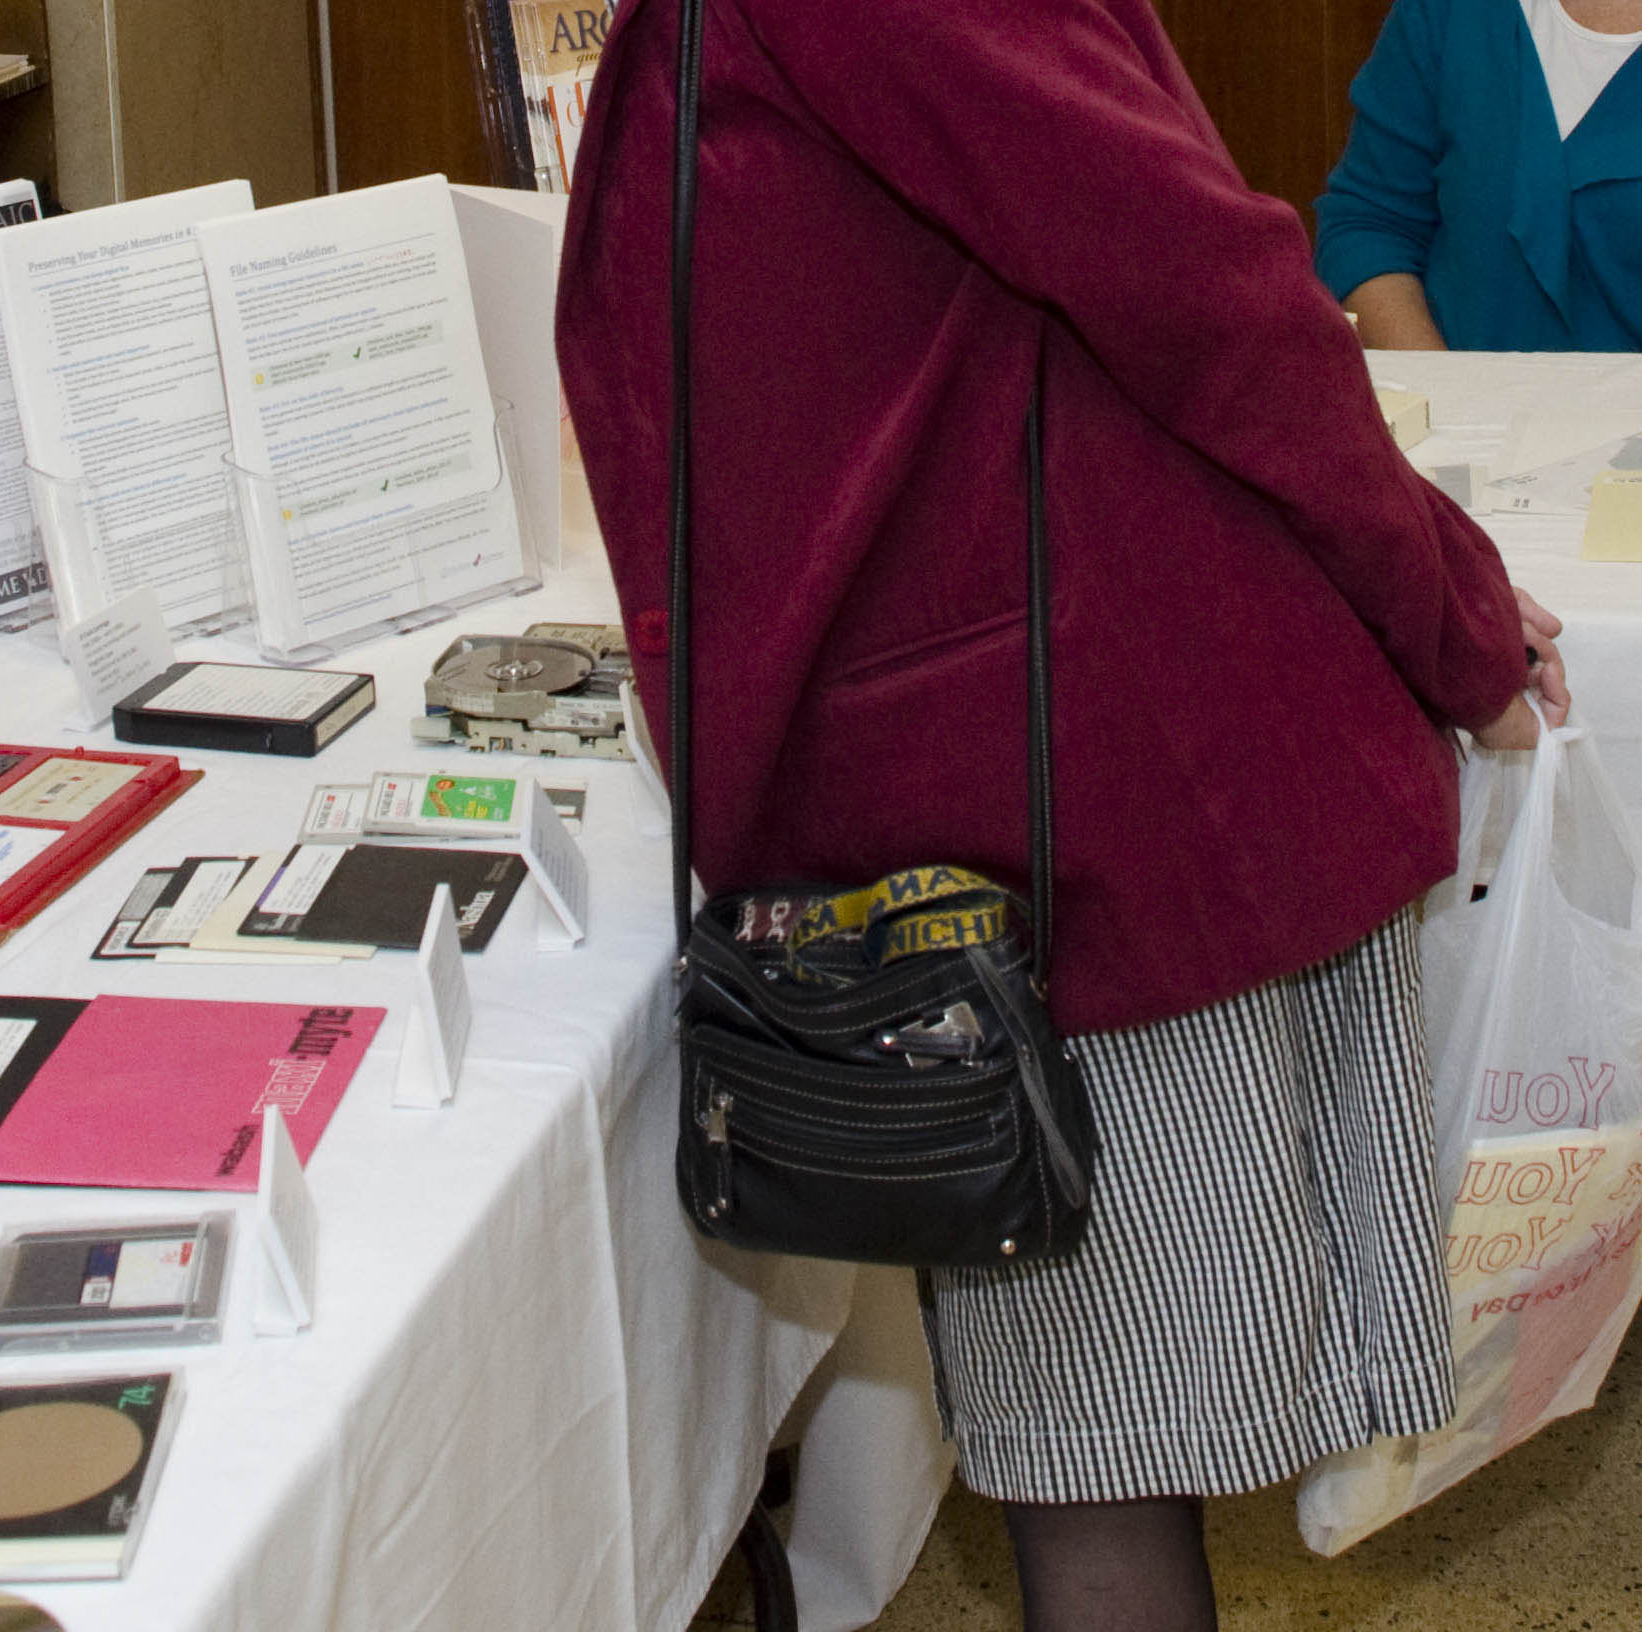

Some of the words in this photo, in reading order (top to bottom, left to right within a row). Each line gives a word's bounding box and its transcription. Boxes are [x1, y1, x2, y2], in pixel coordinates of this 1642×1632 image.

[28, 252, 75, 273] Preserving
[76, 248, 100, 265] Your
[100, 241, 128, 260] Digital
[130, 232, 174, 251] Memories
[229, 263, 248, 277] File
[249, 255, 288, 275] Naming
[287, 244, 338, 265] Guidelines
[117, 1384, 157, 1411] 74
